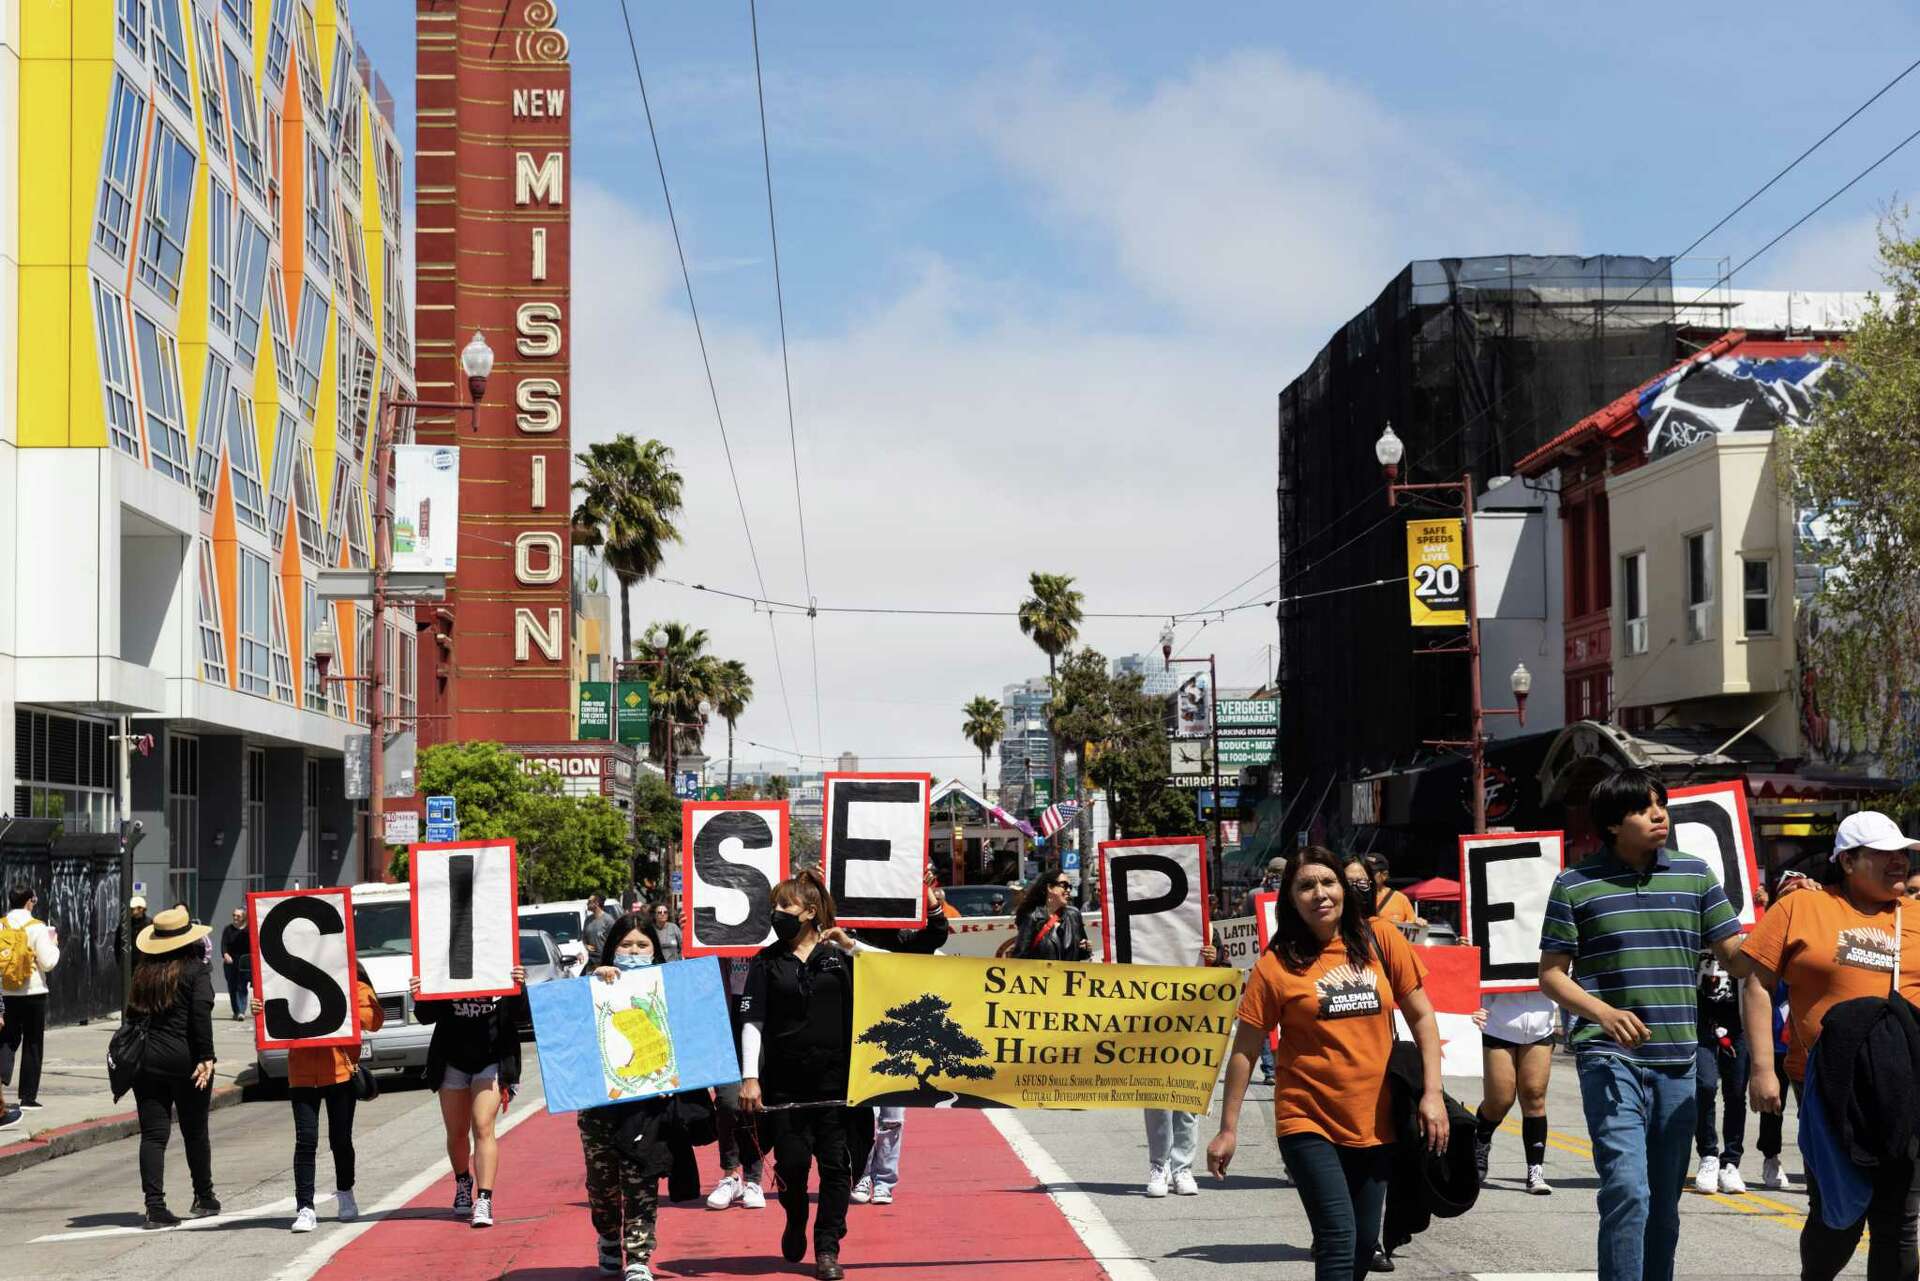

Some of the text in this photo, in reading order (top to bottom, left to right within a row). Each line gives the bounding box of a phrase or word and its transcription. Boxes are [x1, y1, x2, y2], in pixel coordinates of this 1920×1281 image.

[513, 89, 565, 117] NEW
[515, 152, 562, 660] MISSION
[1416, 535, 1454, 544] SPEEDS
[1423, 527, 1447, 535] SAFE
[1414, 563, 1460, 596] 20
[1216, 701, 1276, 715] EVERGREEN
[1217, 741, 1250, 750] RODUCE
[1230, 753, 1248, 761] FOOD
[829, 781, 920, 918] E
[693, 810, 774, 946] S
[449, 854, 474, 980] I
[1110, 854, 1189, 964] P
[1467, 841, 1542, 981] E
[259, 896, 347, 1040] S
[1851, 947, 1894, 960] COLEMAN
[984, 966, 1237, 1002] SAN FRANCISCO
[1332, 992, 1375, 1004] COLEMAN
[984, 1001, 1230, 1036] INTERNATIONAL
[1328, 1000, 1379, 1013] ADVOCATES
[993, 1036, 1218, 1068] HIGH SCHOOL
[1022, 1073, 1047, 1087] SFUSD
